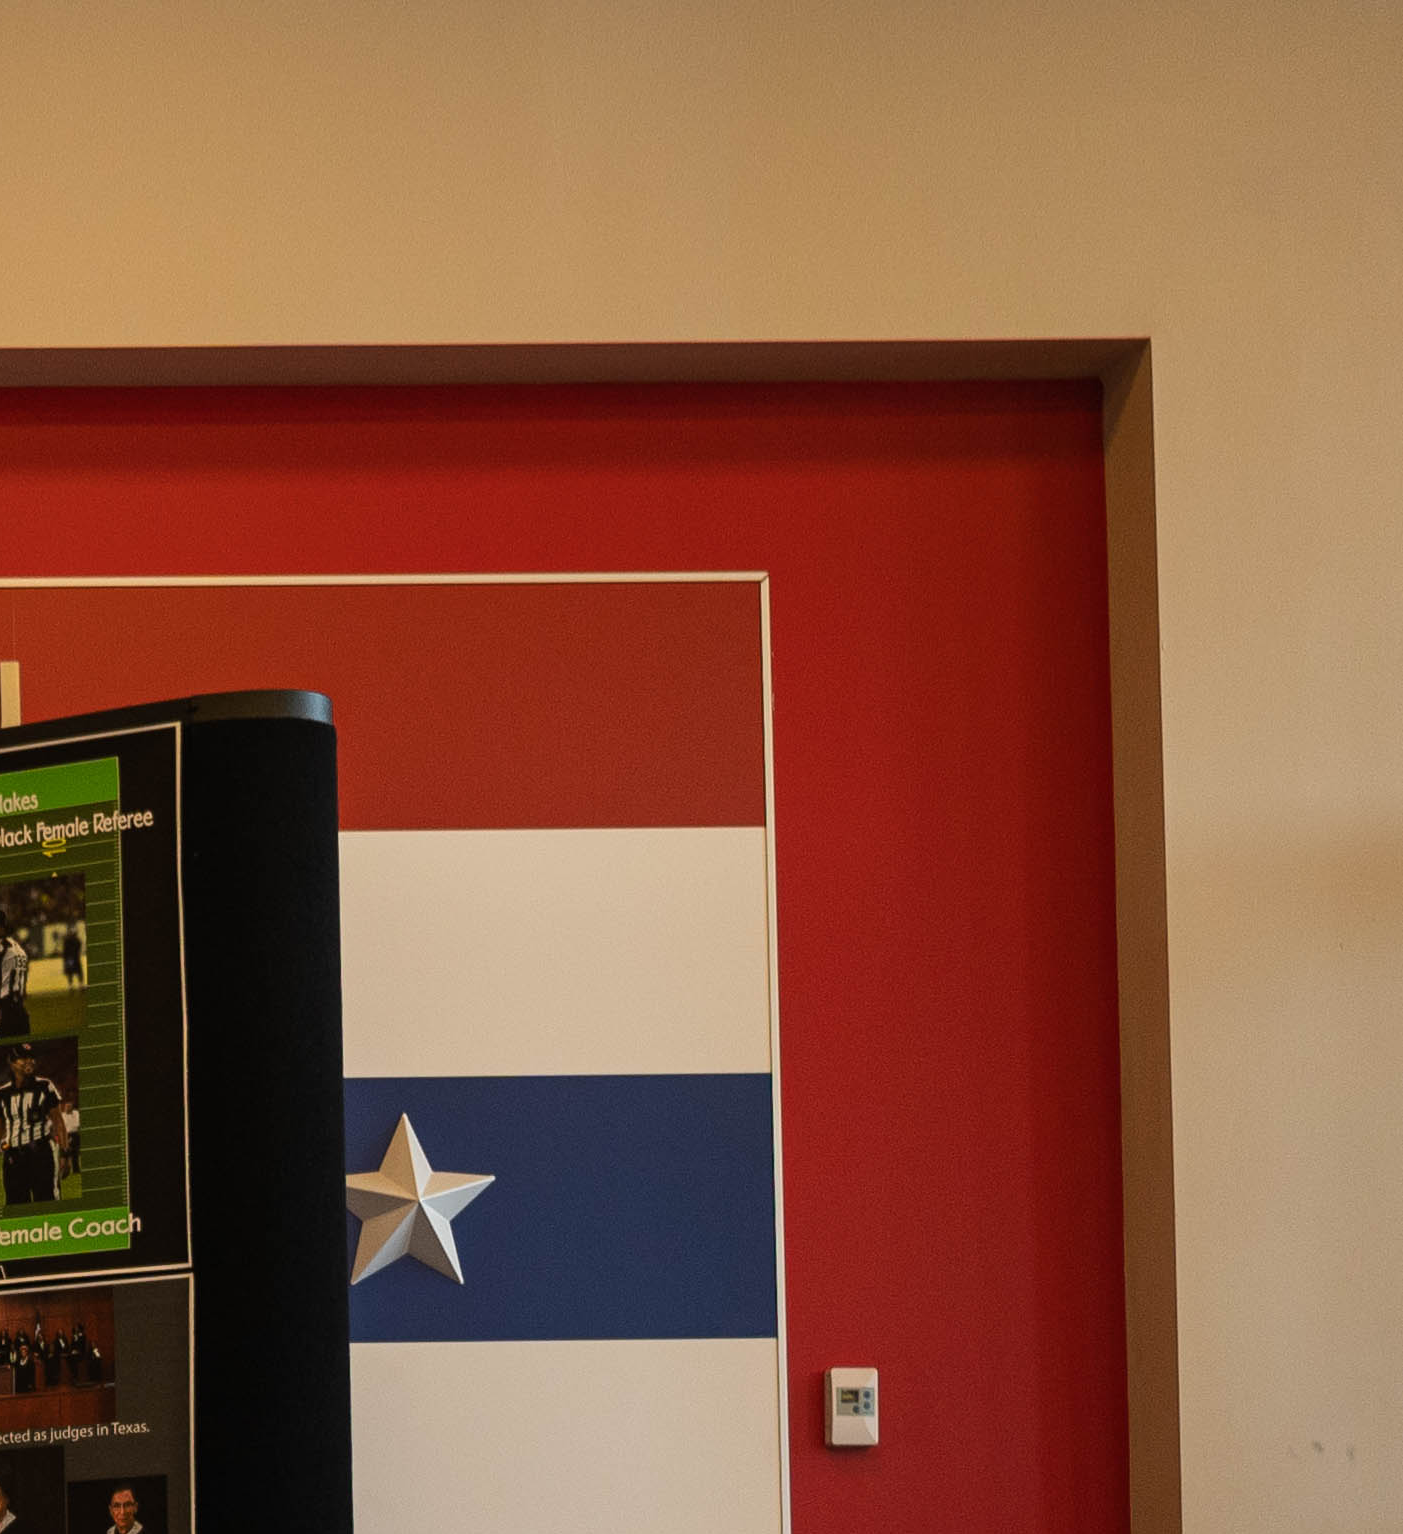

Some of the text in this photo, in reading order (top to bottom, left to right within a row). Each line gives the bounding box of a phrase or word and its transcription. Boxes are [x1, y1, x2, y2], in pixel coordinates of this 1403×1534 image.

[36, 818, 88, 844] Female
[93, 810, 154, 834] Referee
[68, 1212, 141, 1240] Coach
[49, 1425, 93, 1445] judges
[111, 1421, 150, 1436] Texas.
